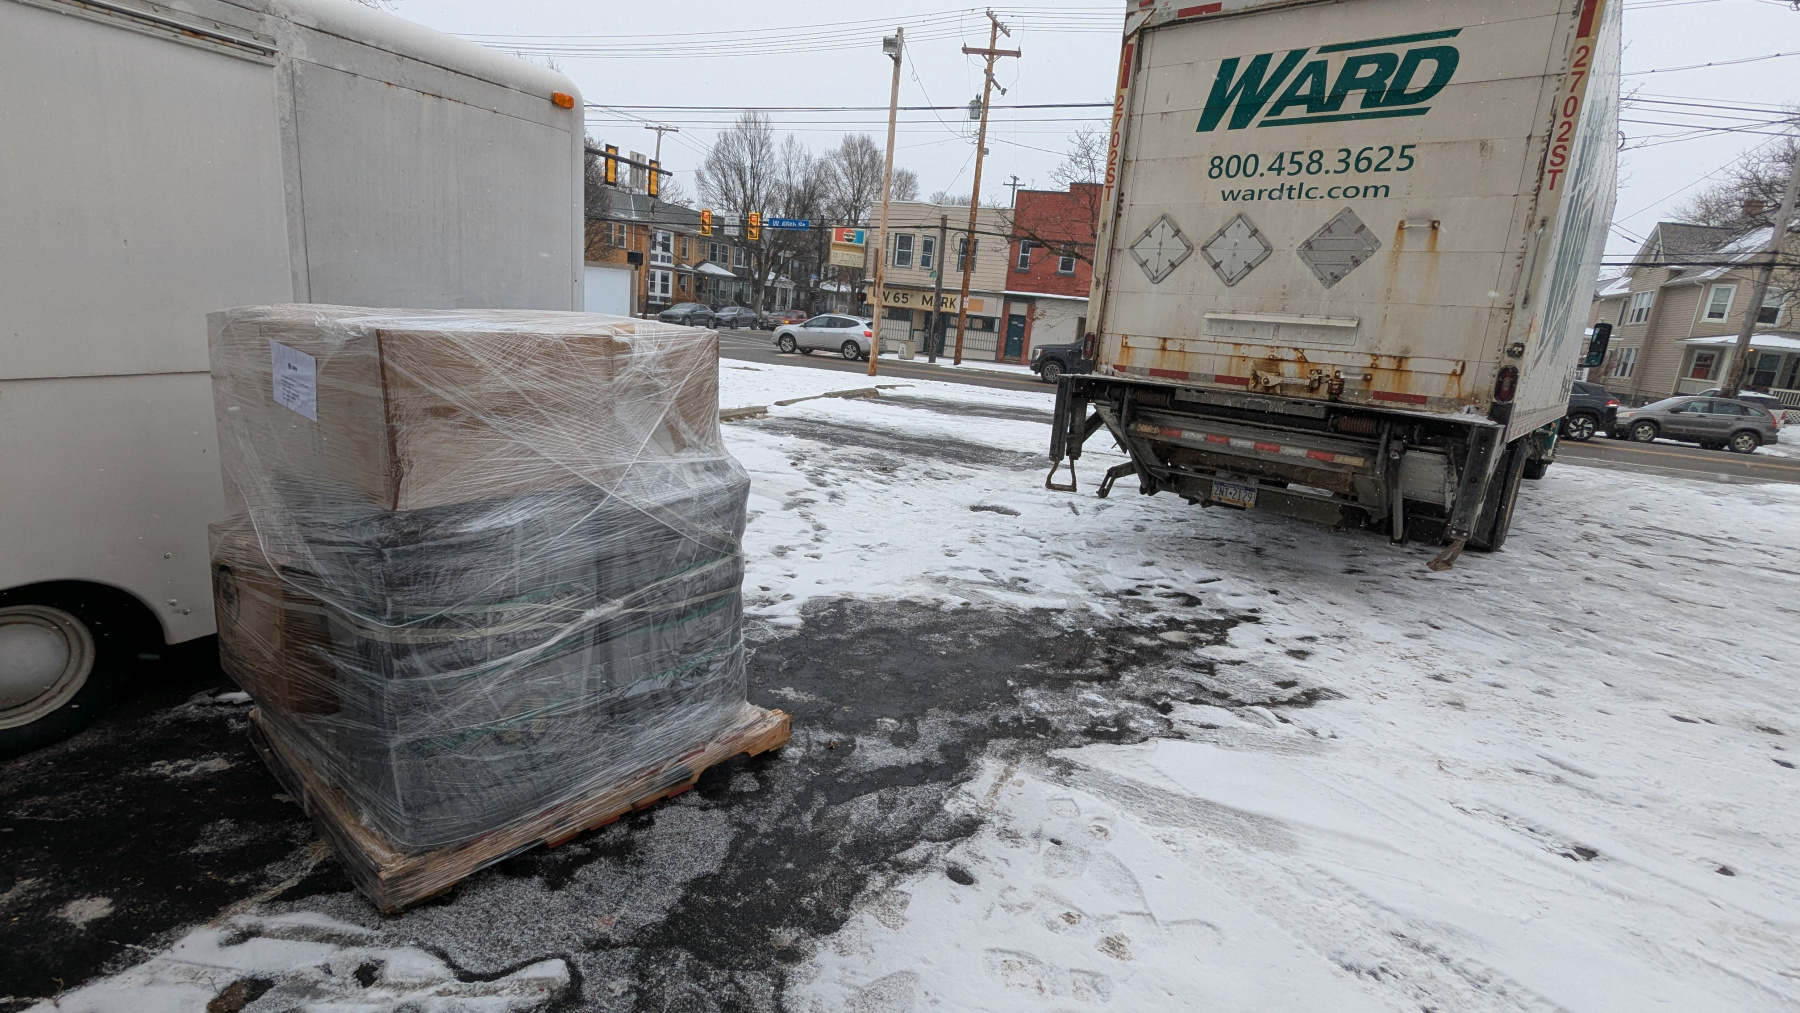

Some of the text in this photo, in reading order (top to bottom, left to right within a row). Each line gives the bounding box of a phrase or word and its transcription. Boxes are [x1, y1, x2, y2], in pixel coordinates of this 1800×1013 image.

[1195, 44, 1460, 133] WARD
[1546, 44, 1590, 191] 2702ST
[1104, 94, 1125, 202] 2702ST
[1207, 144, 1417, 180] 800.458.3625
[1220, 181, 1391, 202] wardtlc.com
[893, 292, 910, 304] 65
[921, 294, 958, 310] MRK
